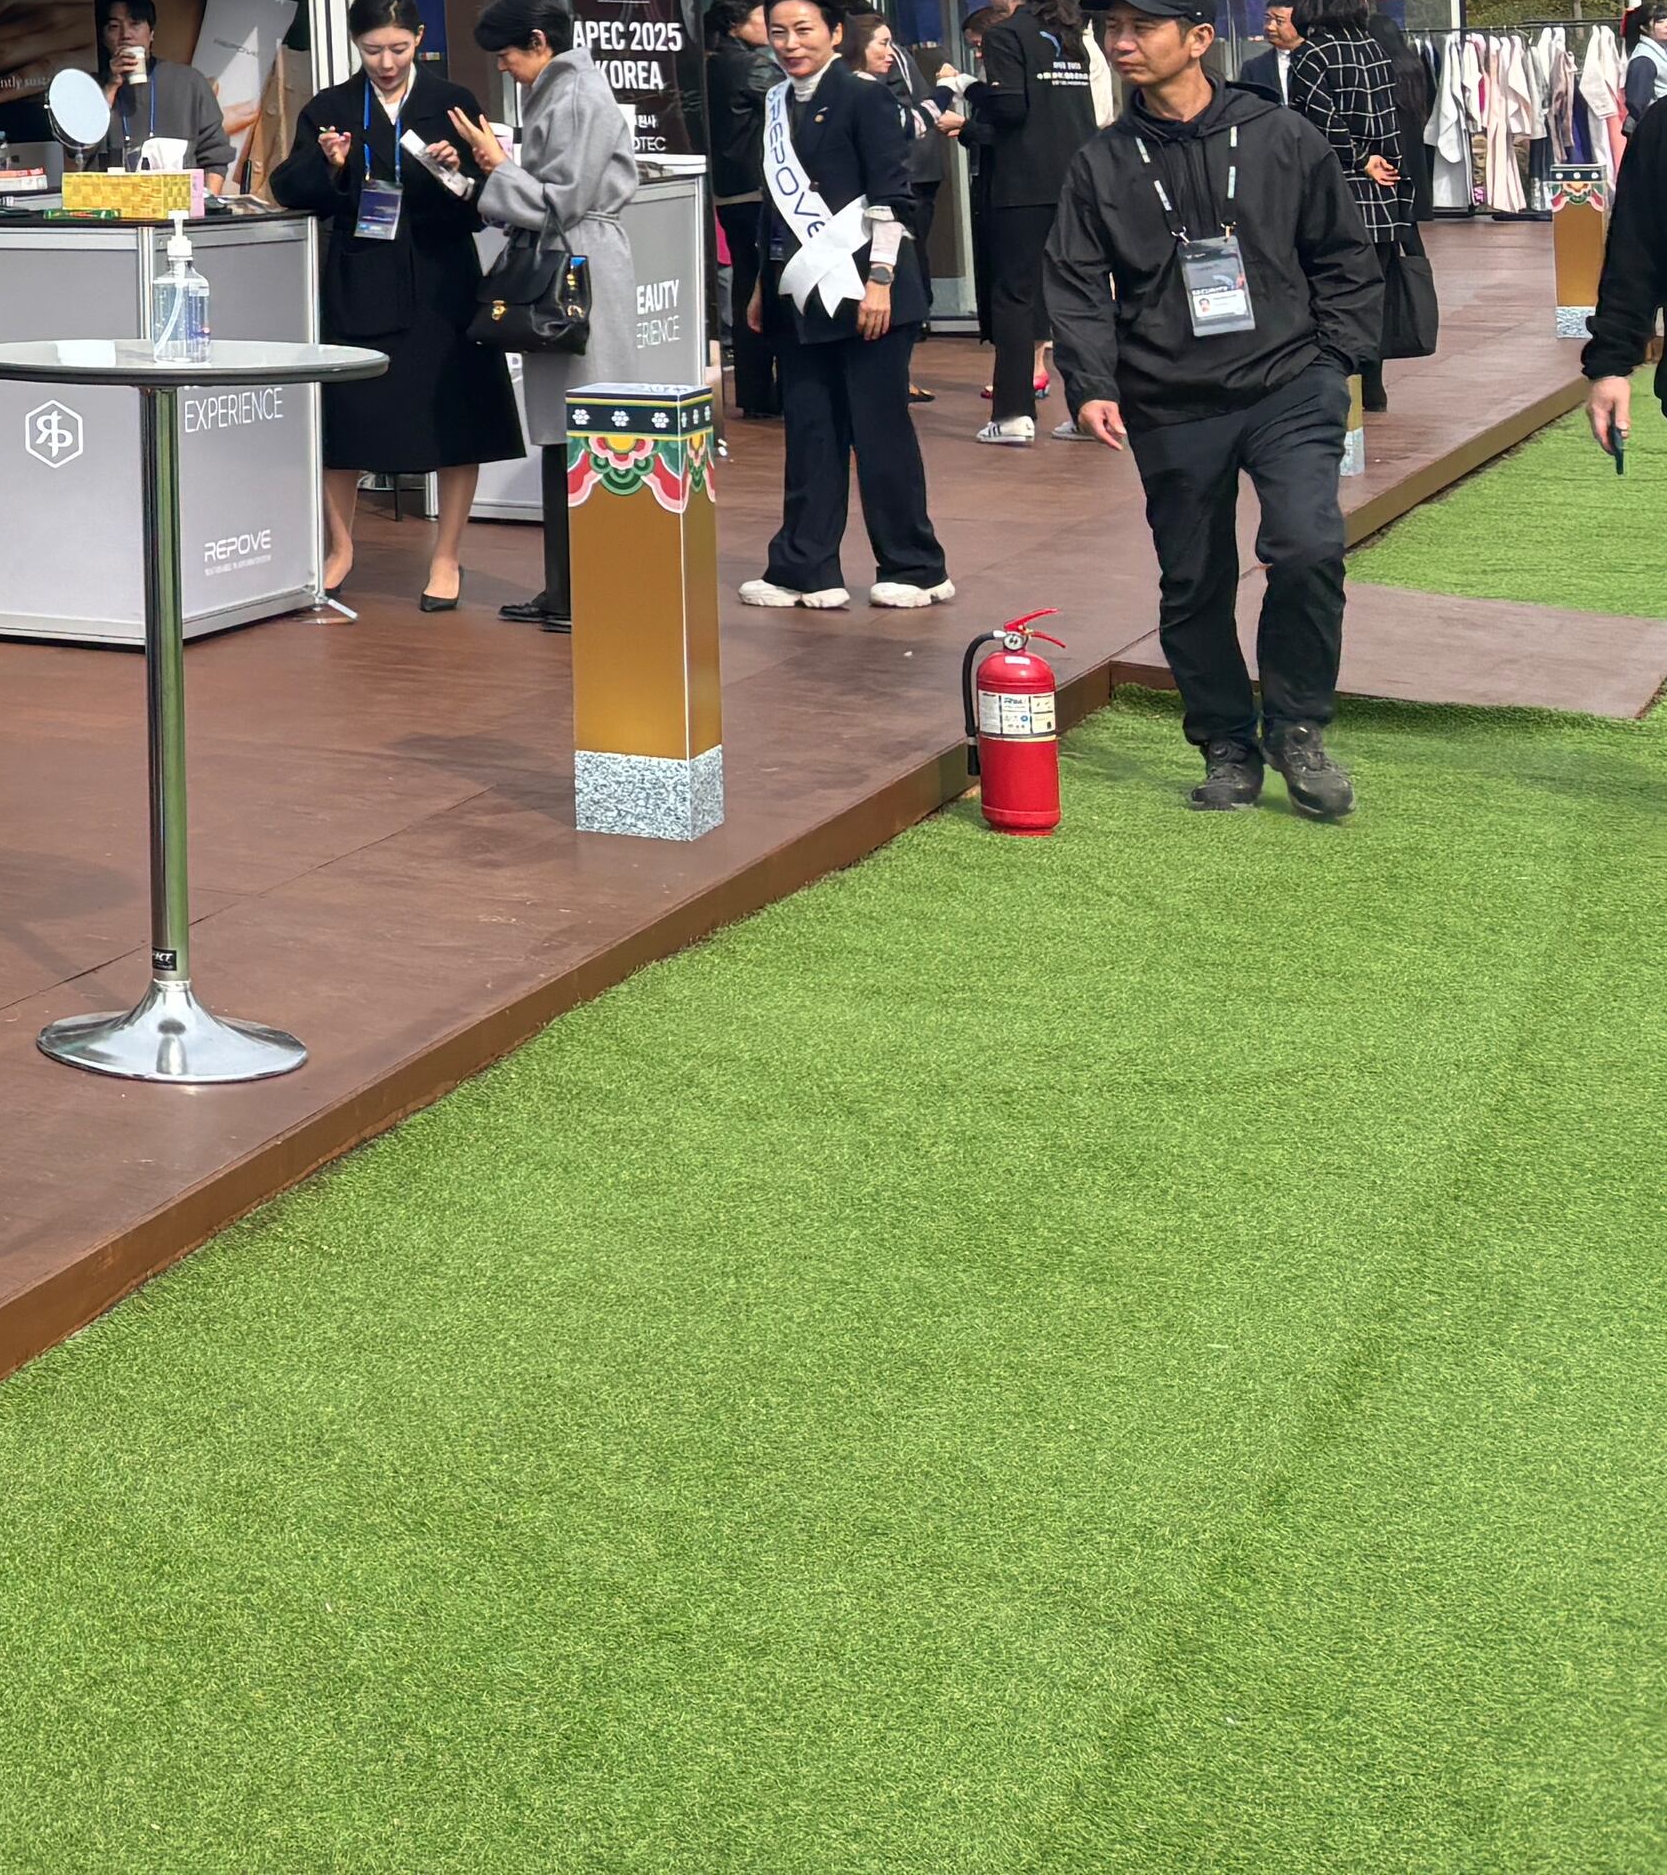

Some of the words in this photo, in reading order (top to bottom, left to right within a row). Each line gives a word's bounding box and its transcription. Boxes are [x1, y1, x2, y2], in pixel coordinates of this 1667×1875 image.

[573, 20, 625, 51] APEC
[629, 21, 683, 52] 2025
[593, 59, 665, 90] KOREA
[636, 279, 679, 315] EAUTY
[184, 387, 283, 433] EXPERIENCE
[204, 529, 272, 562] REPOVE
